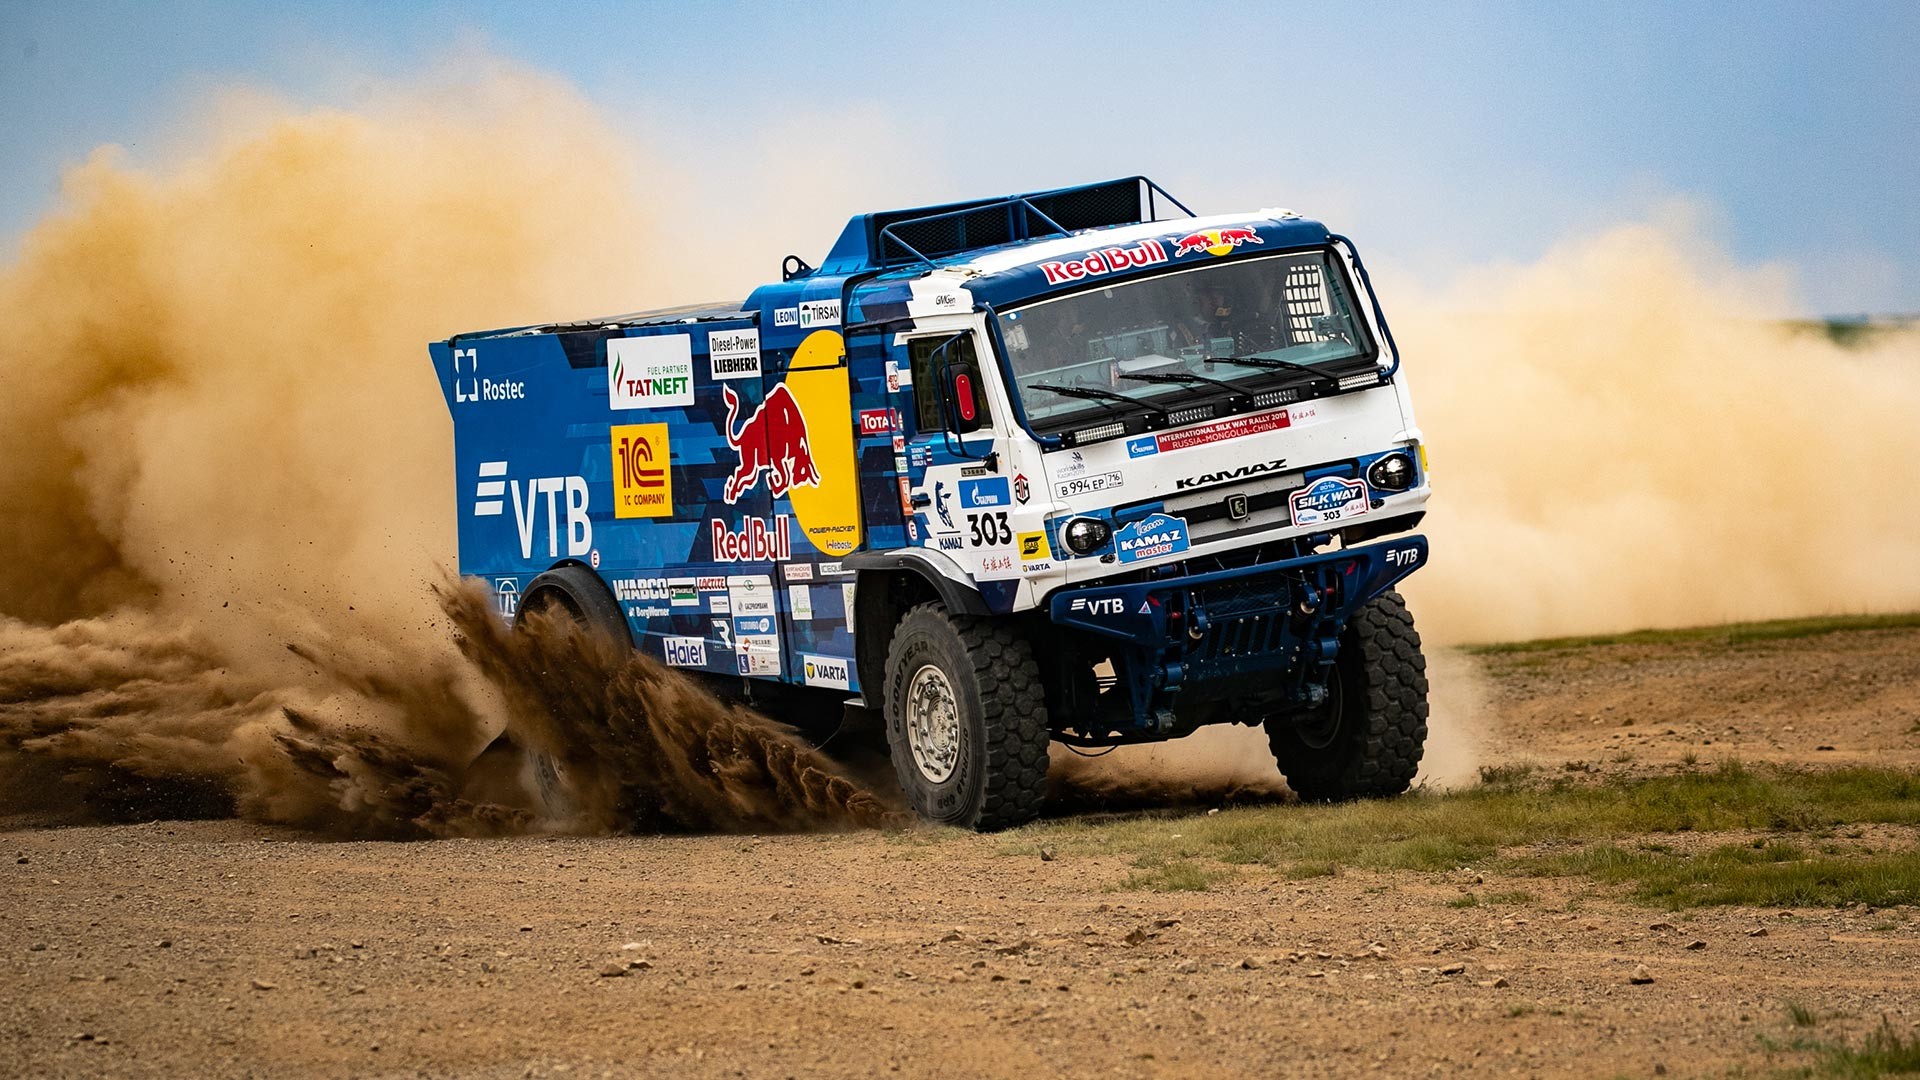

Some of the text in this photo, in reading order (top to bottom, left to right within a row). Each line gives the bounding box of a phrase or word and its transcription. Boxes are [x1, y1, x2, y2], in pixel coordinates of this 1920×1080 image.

[1038, 240, 1168, 285] Red Bull
[776, 310, 797, 323] LEONI
[711, 336, 757, 352] Diesel-Power
[647, 364, 688, 376] FUEL PARTNER
[714, 357, 758, 373] LIEBHERR
[483, 378, 525, 401] Rostec
[626, 376, 689, 397] TATNEFT
[861, 414, 896, 430] TOTAL
[1159, 411, 1287, 443] INTERNATIONAL SILK WAY RALLY 2019
[618, 436, 665, 489] 1C
[1176, 458, 1288, 490] KAMAZ
[1069, 479, 1091, 494] 994
[624, 493, 665, 505] 1C COMPANY
[1298, 493, 1329, 509] SILK
[1331, 487, 1359, 501] WAY
[510, 476, 593, 559] VTB
[1323, 510, 1341, 521] 303
[808, 525, 856, 534] POWER-PACKER
[967, 512, 1013, 547] 303
[1133, 519, 1165, 536] Team
[712, 514, 791, 562] Red Bull
[938, 537, 964, 551] KAMAZ
[1121, 530, 1182, 551] KAMAZ
[1135, 543, 1173, 558] master
[1396, 548, 1418, 567] VTB
[1027, 562, 1051, 572] VARTA
[613, 578, 670, 601] WABCO
[698, 578, 725, 590] LOCTITE
[1087, 598, 1125, 616] VTB
[666, 639, 703, 664] Haier
[816, 664, 848, 681] VARTA
